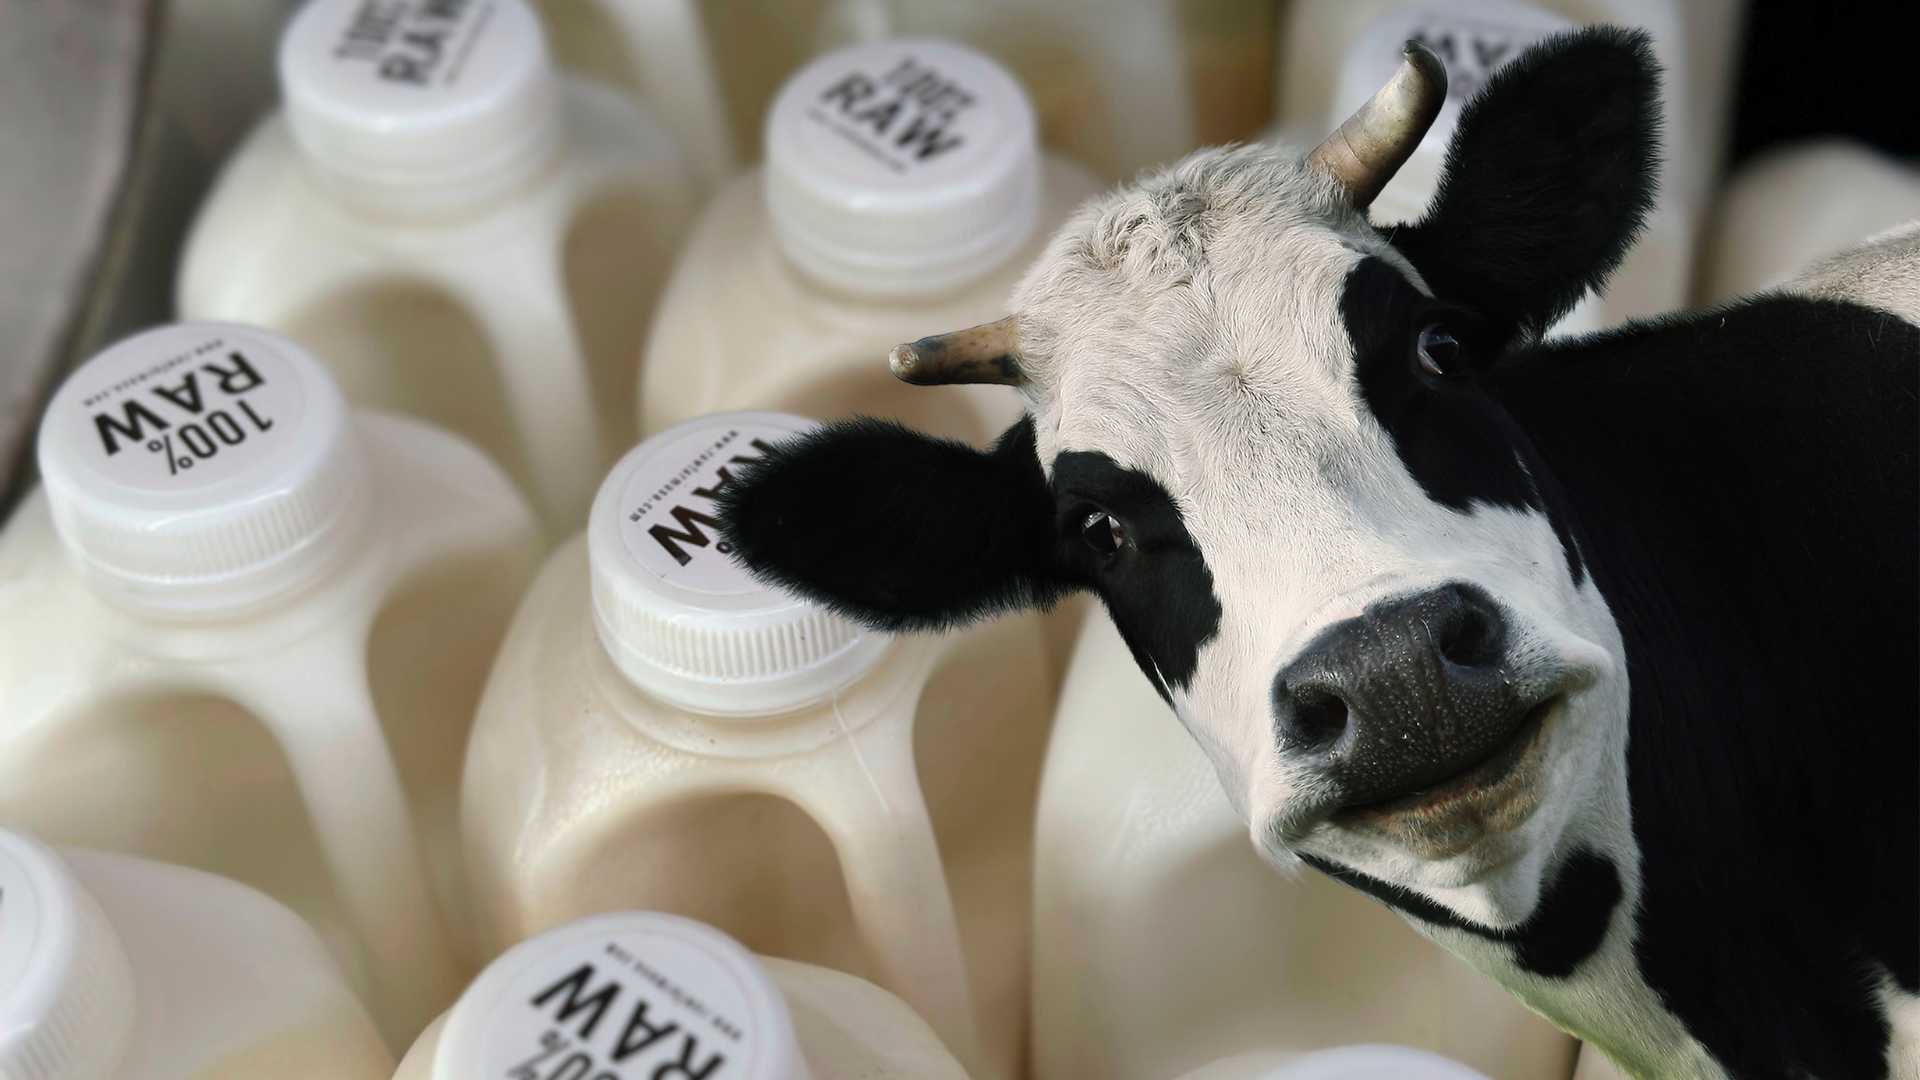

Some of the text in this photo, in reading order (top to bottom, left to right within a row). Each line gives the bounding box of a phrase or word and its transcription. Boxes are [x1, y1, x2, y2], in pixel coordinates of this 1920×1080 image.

[820, 72, 964, 162] RAW
[94, 351, 266, 456] RAW
[147, 399, 275, 476] 100%
[530, 962, 724, 1080] RAW
